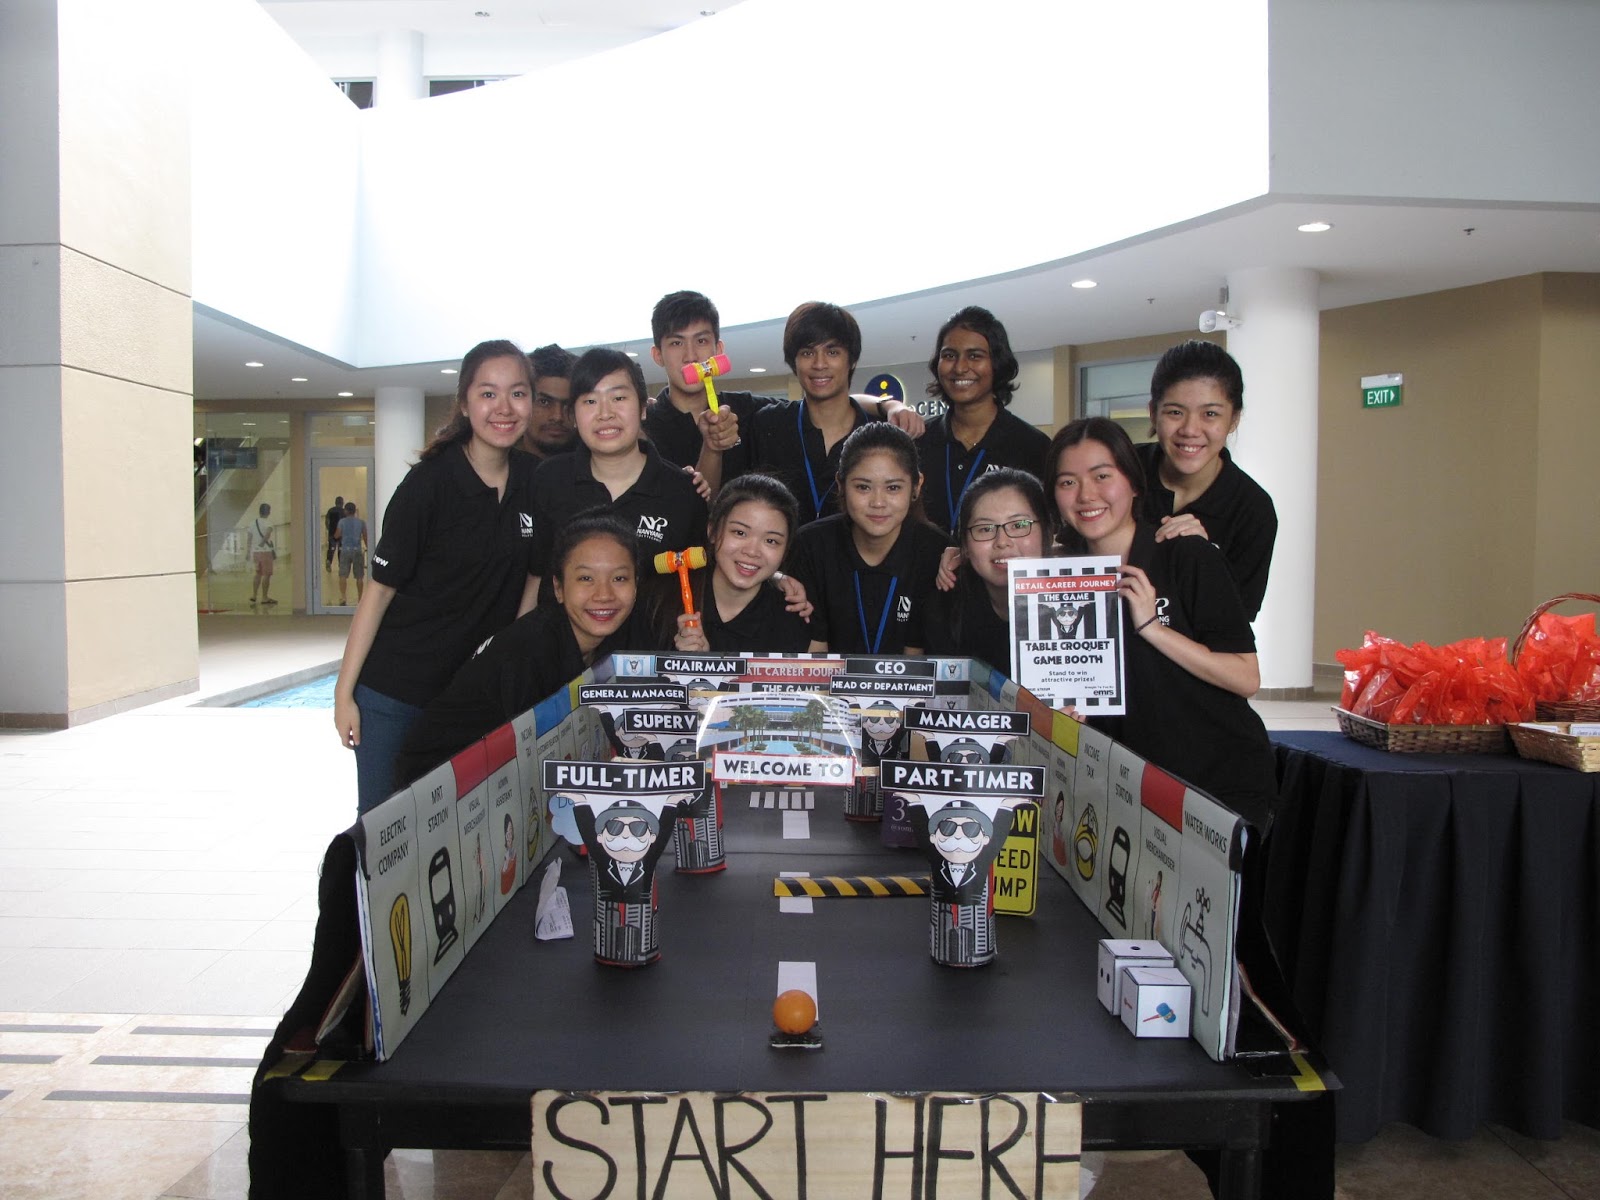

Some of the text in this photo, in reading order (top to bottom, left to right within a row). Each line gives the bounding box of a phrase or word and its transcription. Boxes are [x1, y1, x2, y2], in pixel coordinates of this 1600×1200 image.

[1367, 389, 1389, 405] EXIT
[1015, 579, 1116, 590] RETAIL CAREER JOURNEY
[1044, 592, 1089, 601] THE GAME
[1025, 641, 1110, 652] TABLE CROQUET
[664, 659, 737, 672] CHAIRMAN
[875, 661, 906, 675] CEO
[1033, 654, 1103, 665] GAME BOOTH
[765, 667, 805, 676] CAREER
[581, 690, 685, 699] GENERAL MANAGER
[831, 680, 933, 693] HEAD OF DEPARTMENT
[919, 711, 1012, 730] MANAGER
[1084, 743, 1100, 762] INCOME
[556, 765, 696, 789] FULL-TIMER
[723, 759, 844, 778] WELCOME TO
[894, 766, 1034, 790] PART-TIMER
[1119, 763, 1130, 780] MRT
[431, 785, 443, 804] MRT
[1115, 783, 1133, 806] STATION
[427, 807, 449, 833] STATION
[380, 815, 407, 847] ELECTRIC
[1184, 810, 1227, 854] WATER WORKS
[378, 840, 409, 876] COMPANY
[542, 1095, 827, 1200] START
